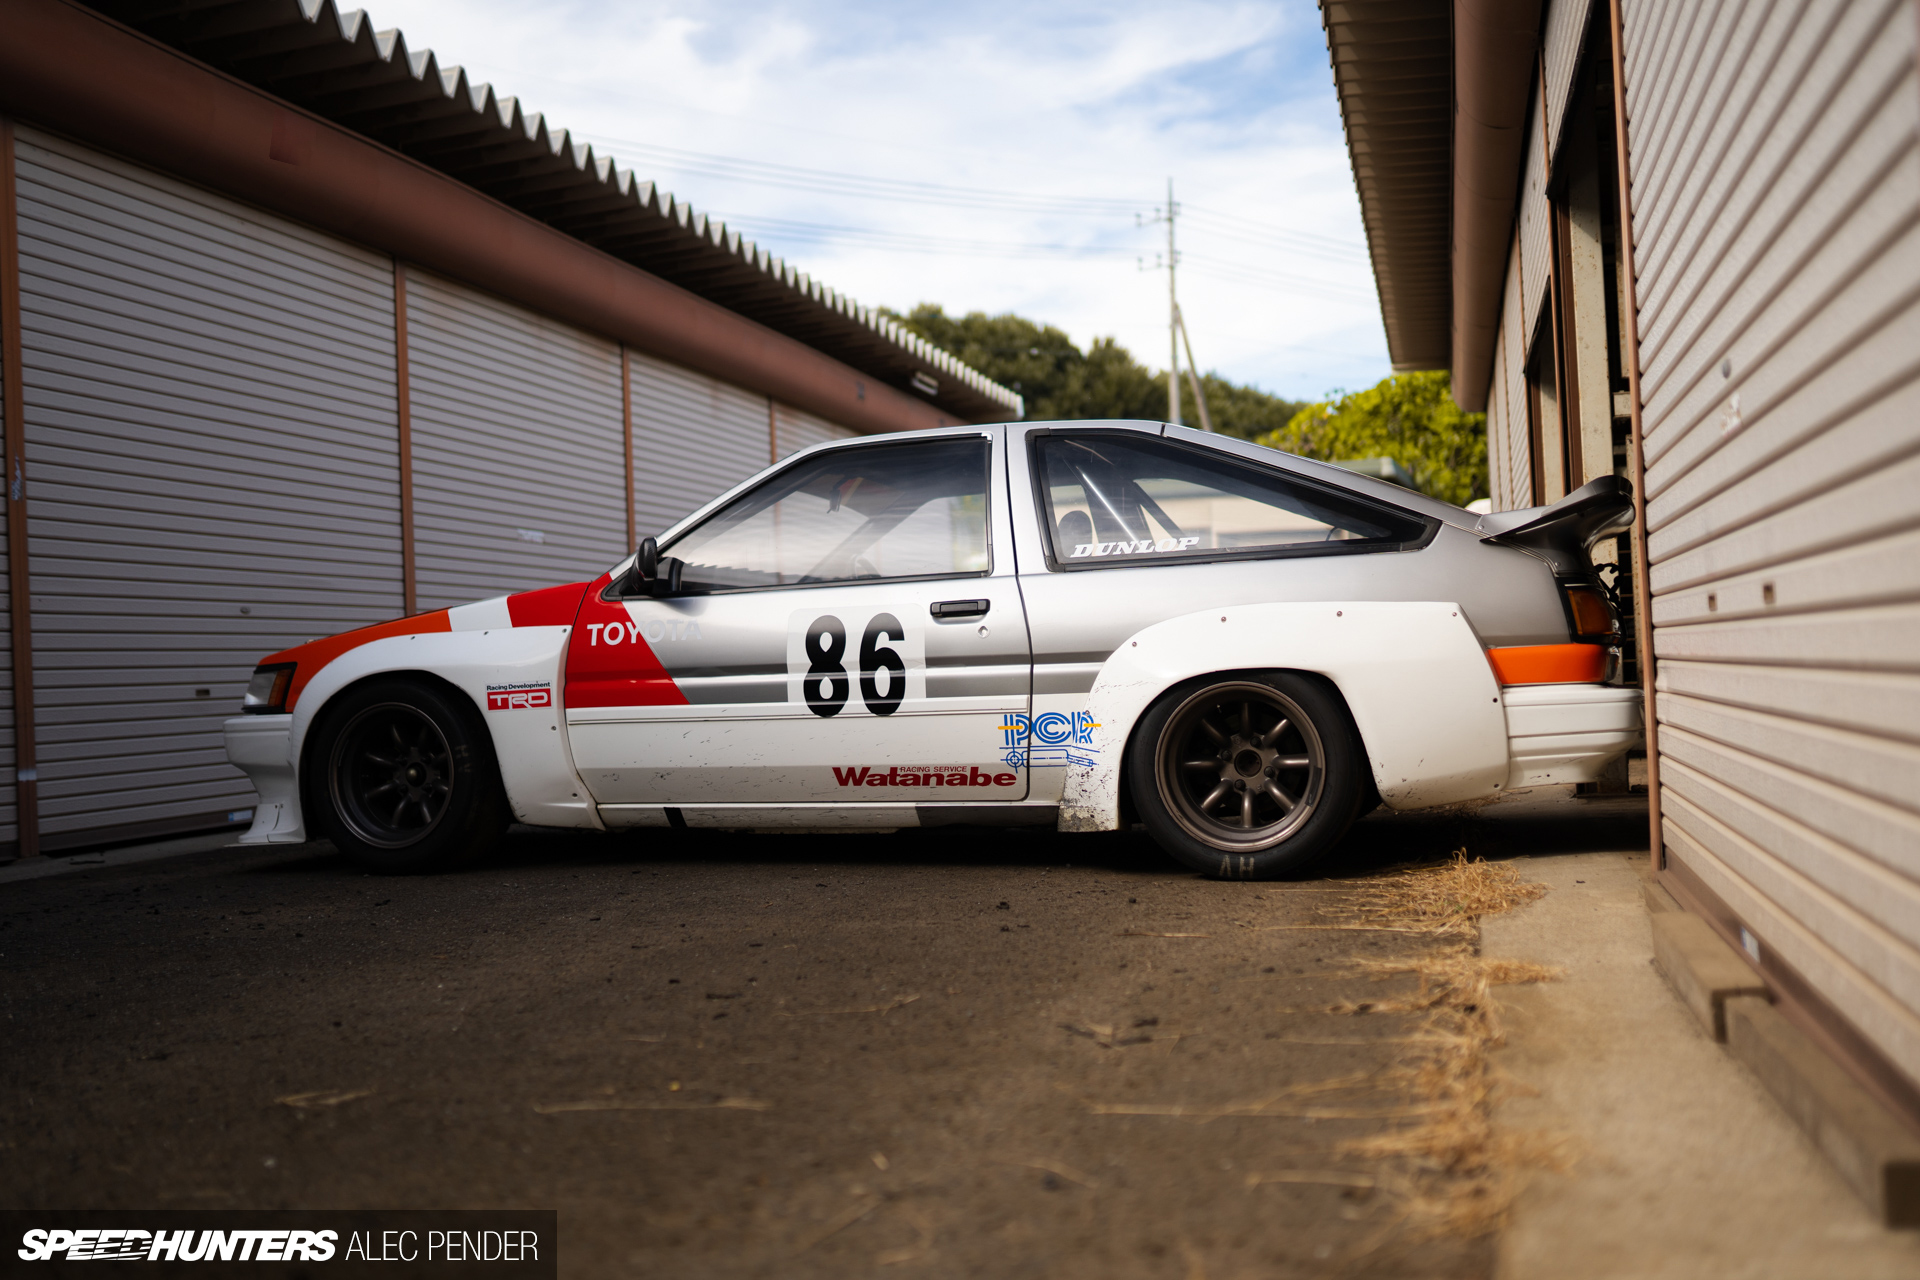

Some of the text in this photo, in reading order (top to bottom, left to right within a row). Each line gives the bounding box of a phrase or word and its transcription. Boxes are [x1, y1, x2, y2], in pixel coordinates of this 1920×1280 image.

[1070, 536, 1200, 558] DUNLOP
[587, 619, 702, 646] TOYOTA
[803, 612, 906, 718] 86
[508, 681, 550, 690] Development
[489, 691, 548, 710] TRD
[832, 766, 1017, 787] Watanabe
[933, 765, 968, 773] SERVICE
